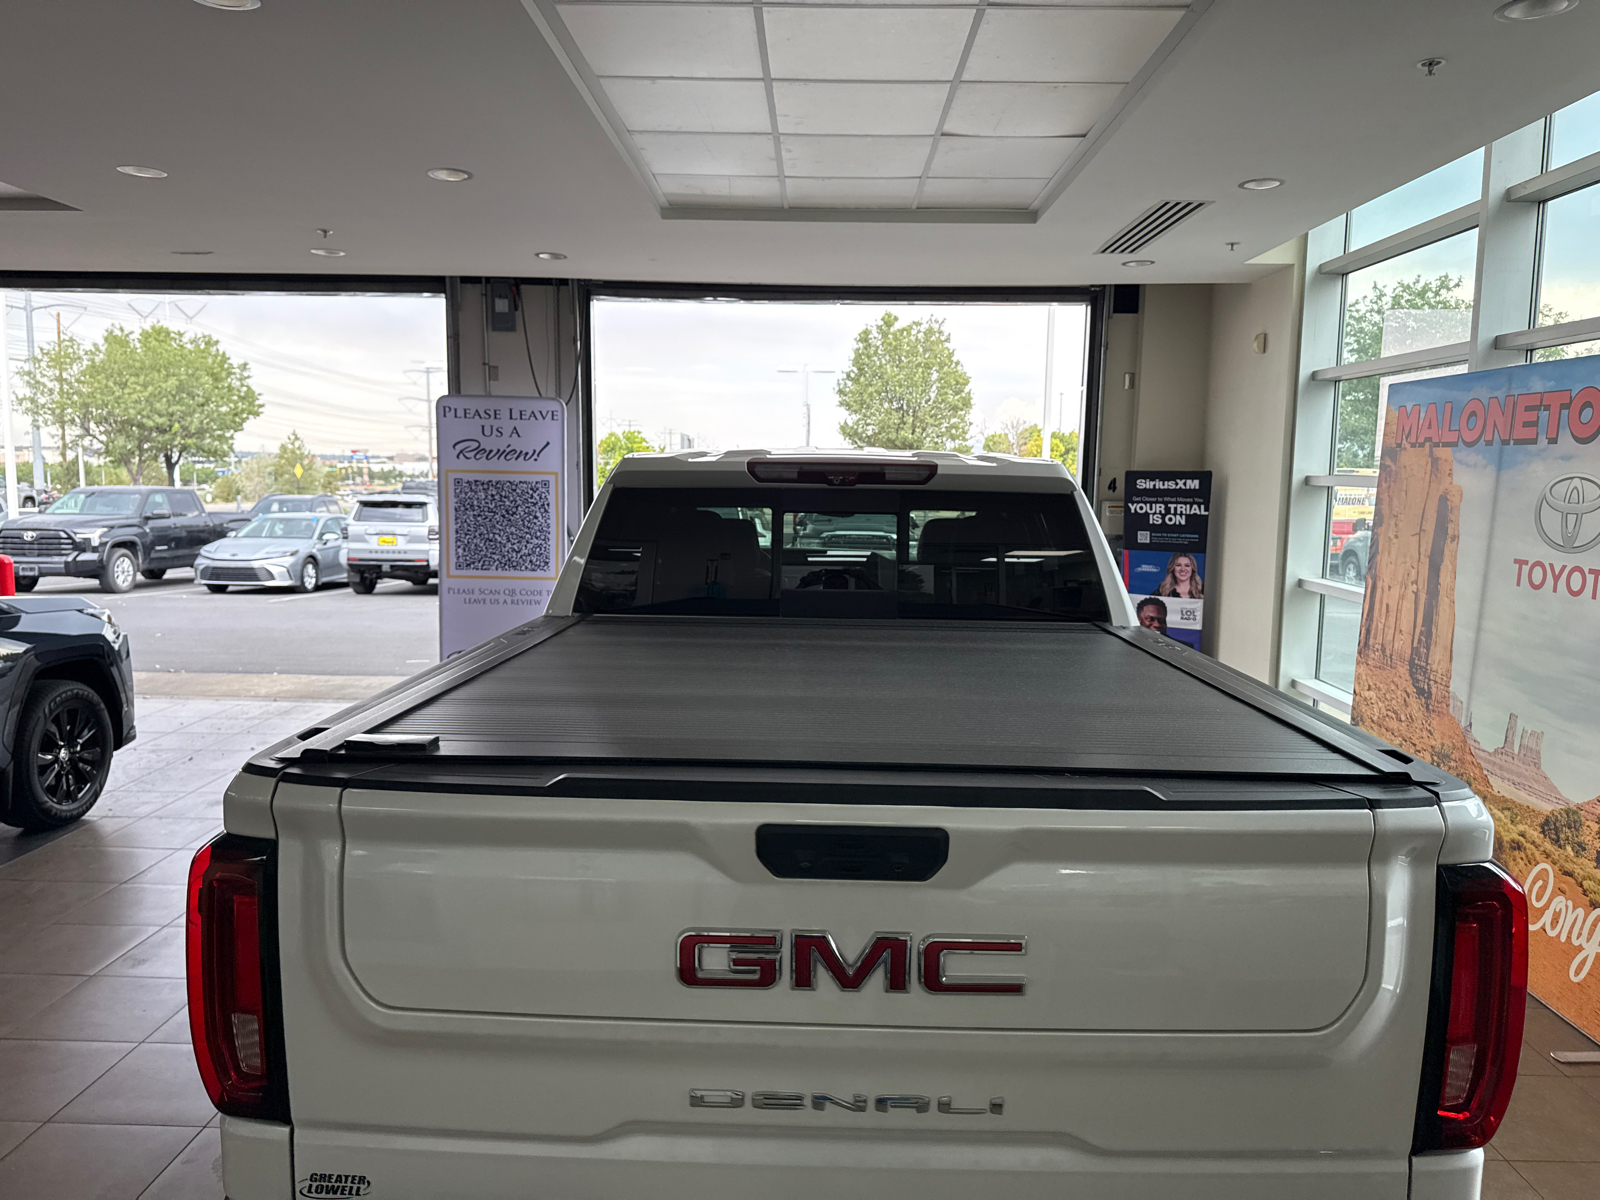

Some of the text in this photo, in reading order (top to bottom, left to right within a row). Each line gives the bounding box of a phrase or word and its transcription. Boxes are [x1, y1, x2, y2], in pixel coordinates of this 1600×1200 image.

[443, 405, 559, 421] PLEASE LEAVE
[481, 425, 521, 438] US A
[452, 439, 550, 461] Review!
[1108, 477, 1117, 493] 4
[1136, 479, 1199, 489] SiriusXM
[1128, 503, 1165, 513] YOUR
[1168, 504, 1209, 515] TRIAL
[1149, 514, 1186, 525] IS ON
[1513, 558, 1600, 600] TOYOT
[504, 588, 517, 597] QR
[676, 927, 1027, 996] GMC
[689, 1088, 1006, 1116] DENALI
[310, 1172, 366, 1185] GREATER
[307, 1184, 361, 1196] LOWELL
